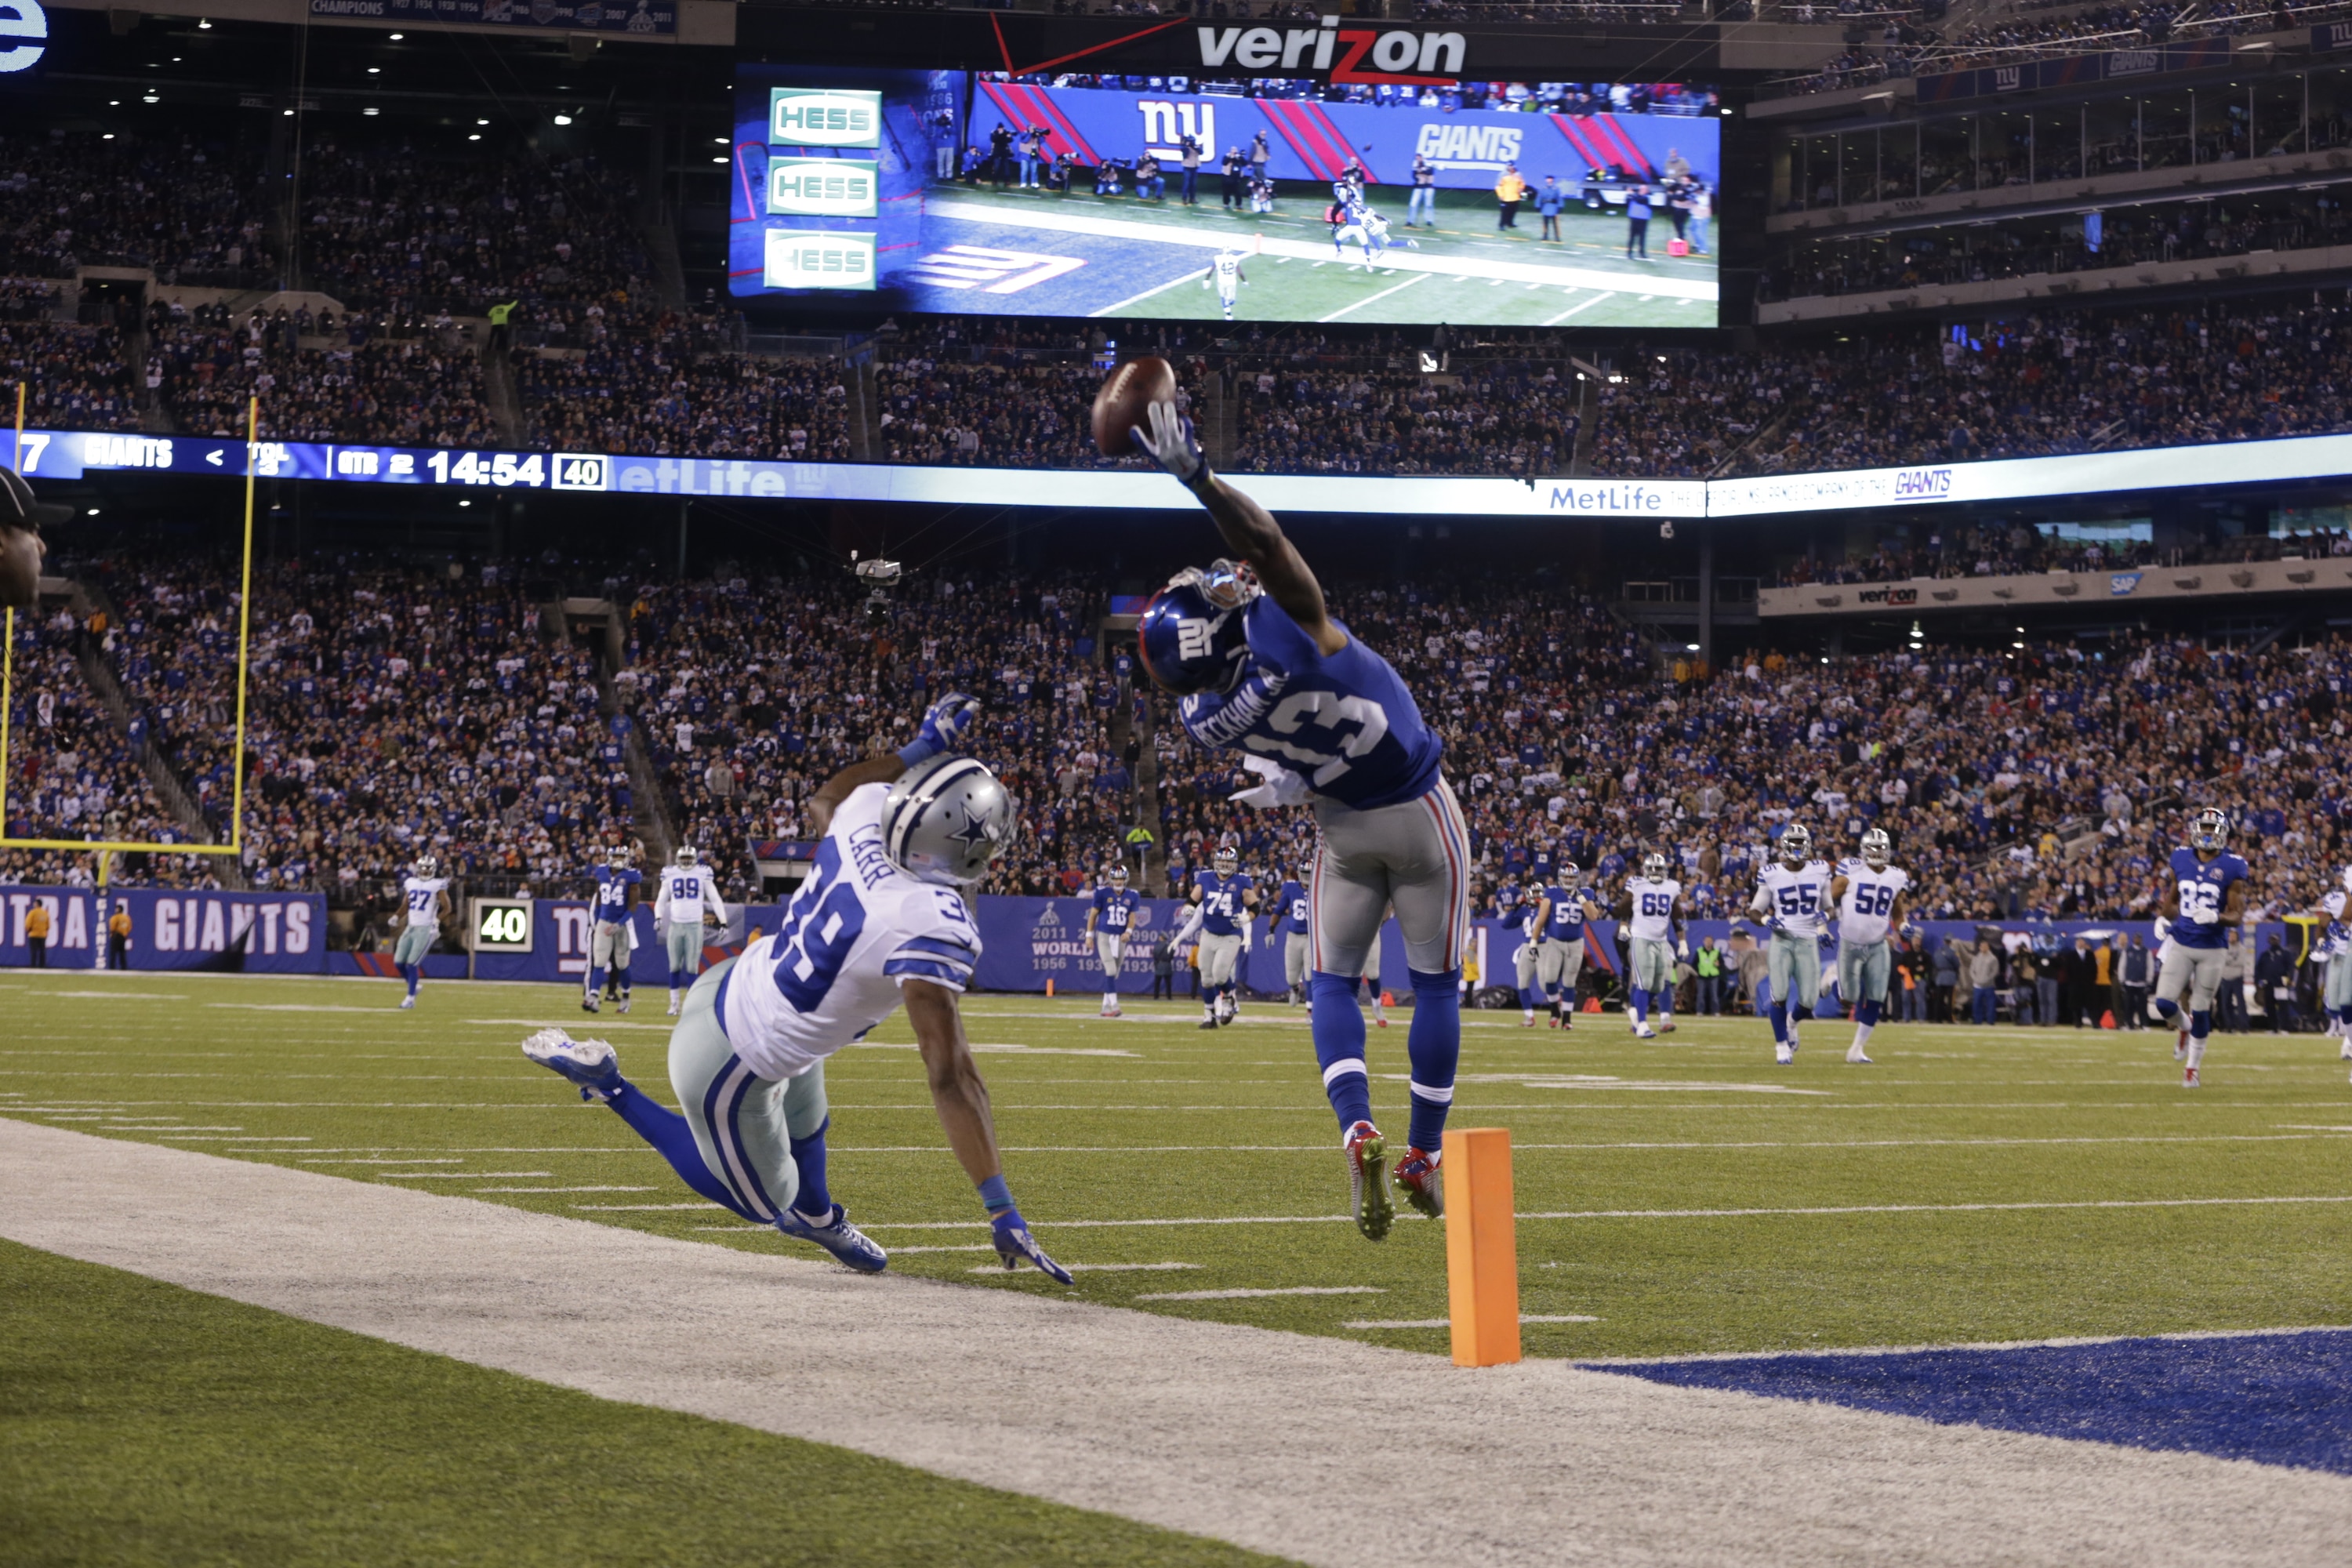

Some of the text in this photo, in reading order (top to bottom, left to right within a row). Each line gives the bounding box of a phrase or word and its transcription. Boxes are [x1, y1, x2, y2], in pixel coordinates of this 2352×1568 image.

[311, 0, 383, 15] CHAMPIONS
[1198, 15, 1466, 85] verizon
[781, 106, 869, 131] HESS
[1417, 122, 1523, 171] GIANTS
[779, 175, 868, 200] HESS
[20, 434, 50, 472] 7
[85, 436, 172, 468] GIANTS
[390, 454, 414, 474] 2
[427, 451, 545, 486] 14:54
[564, 460, 599, 485] 40
[1550, 485, 1661, 510] MetLife
[1894, 470, 1951, 501] GIANTS
[1859, 586, 1917, 606] verizon
[2111, 576, 2136, 592] SAP
[1243, 691, 1389, 788] 13
[849, 822, 895, 891] CARR
[408, 889, 431, 911] 27
[599, 883, 624, 906] 84
[672, 877, 699, 899] 99
[1777, 883, 1817, 916] 55
[1855, 882, 1893, 916] 58
[2178, 880, 2221, 919] 82
[1106, 905, 1128, 927] 10
[1206, 891, 1233, 916] 74
[1555, 902, 1583, 924] 55
[1642, 893, 1671, 917] 69
[156, 899, 311, 955] GIANTS
[481, 908, 527, 942] 40
[1032, 927, 1067, 940] 2011
[1131, 930, 1159, 942] 990
[1032, 942, 1094, 956] WORLD
[1032, 957, 1067, 971] 1956
[1078, 958, 1104, 971] 193
